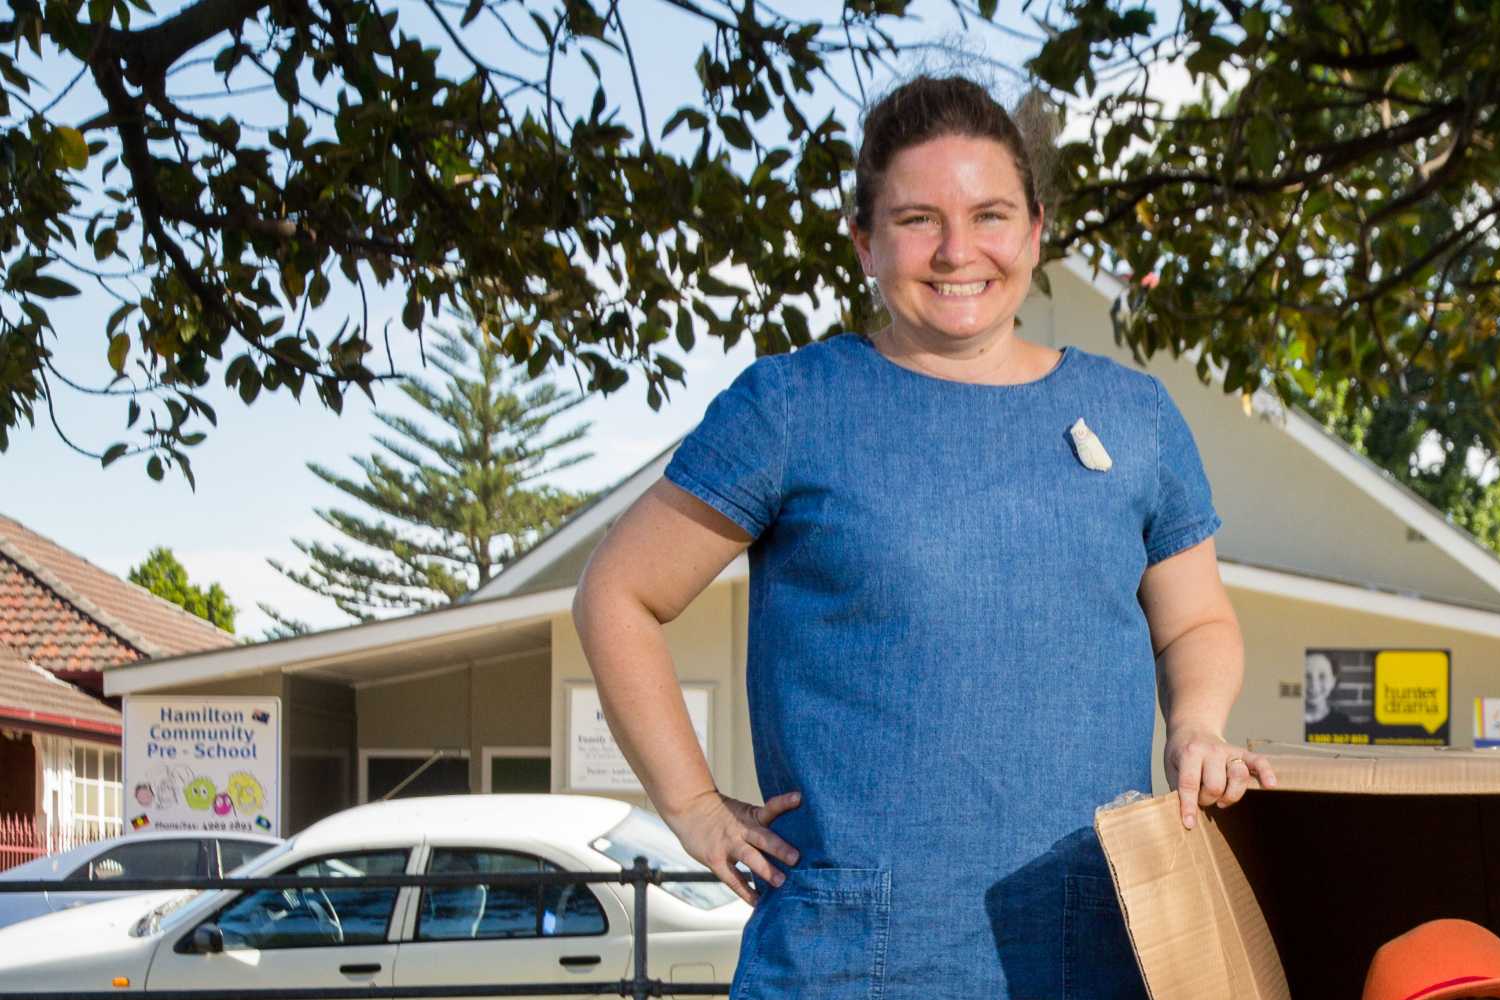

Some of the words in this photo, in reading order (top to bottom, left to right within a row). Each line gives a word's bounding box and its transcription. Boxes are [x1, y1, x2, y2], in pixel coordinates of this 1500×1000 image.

[1384, 684, 1438, 698] hunter
[1384, 699, 1439, 714] drama
[160, 707, 244, 723] Hamilton
[149, 724, 254, 742] Community
[147, 743, 177, 759] Pre
[194, 743, 257, 759] School
